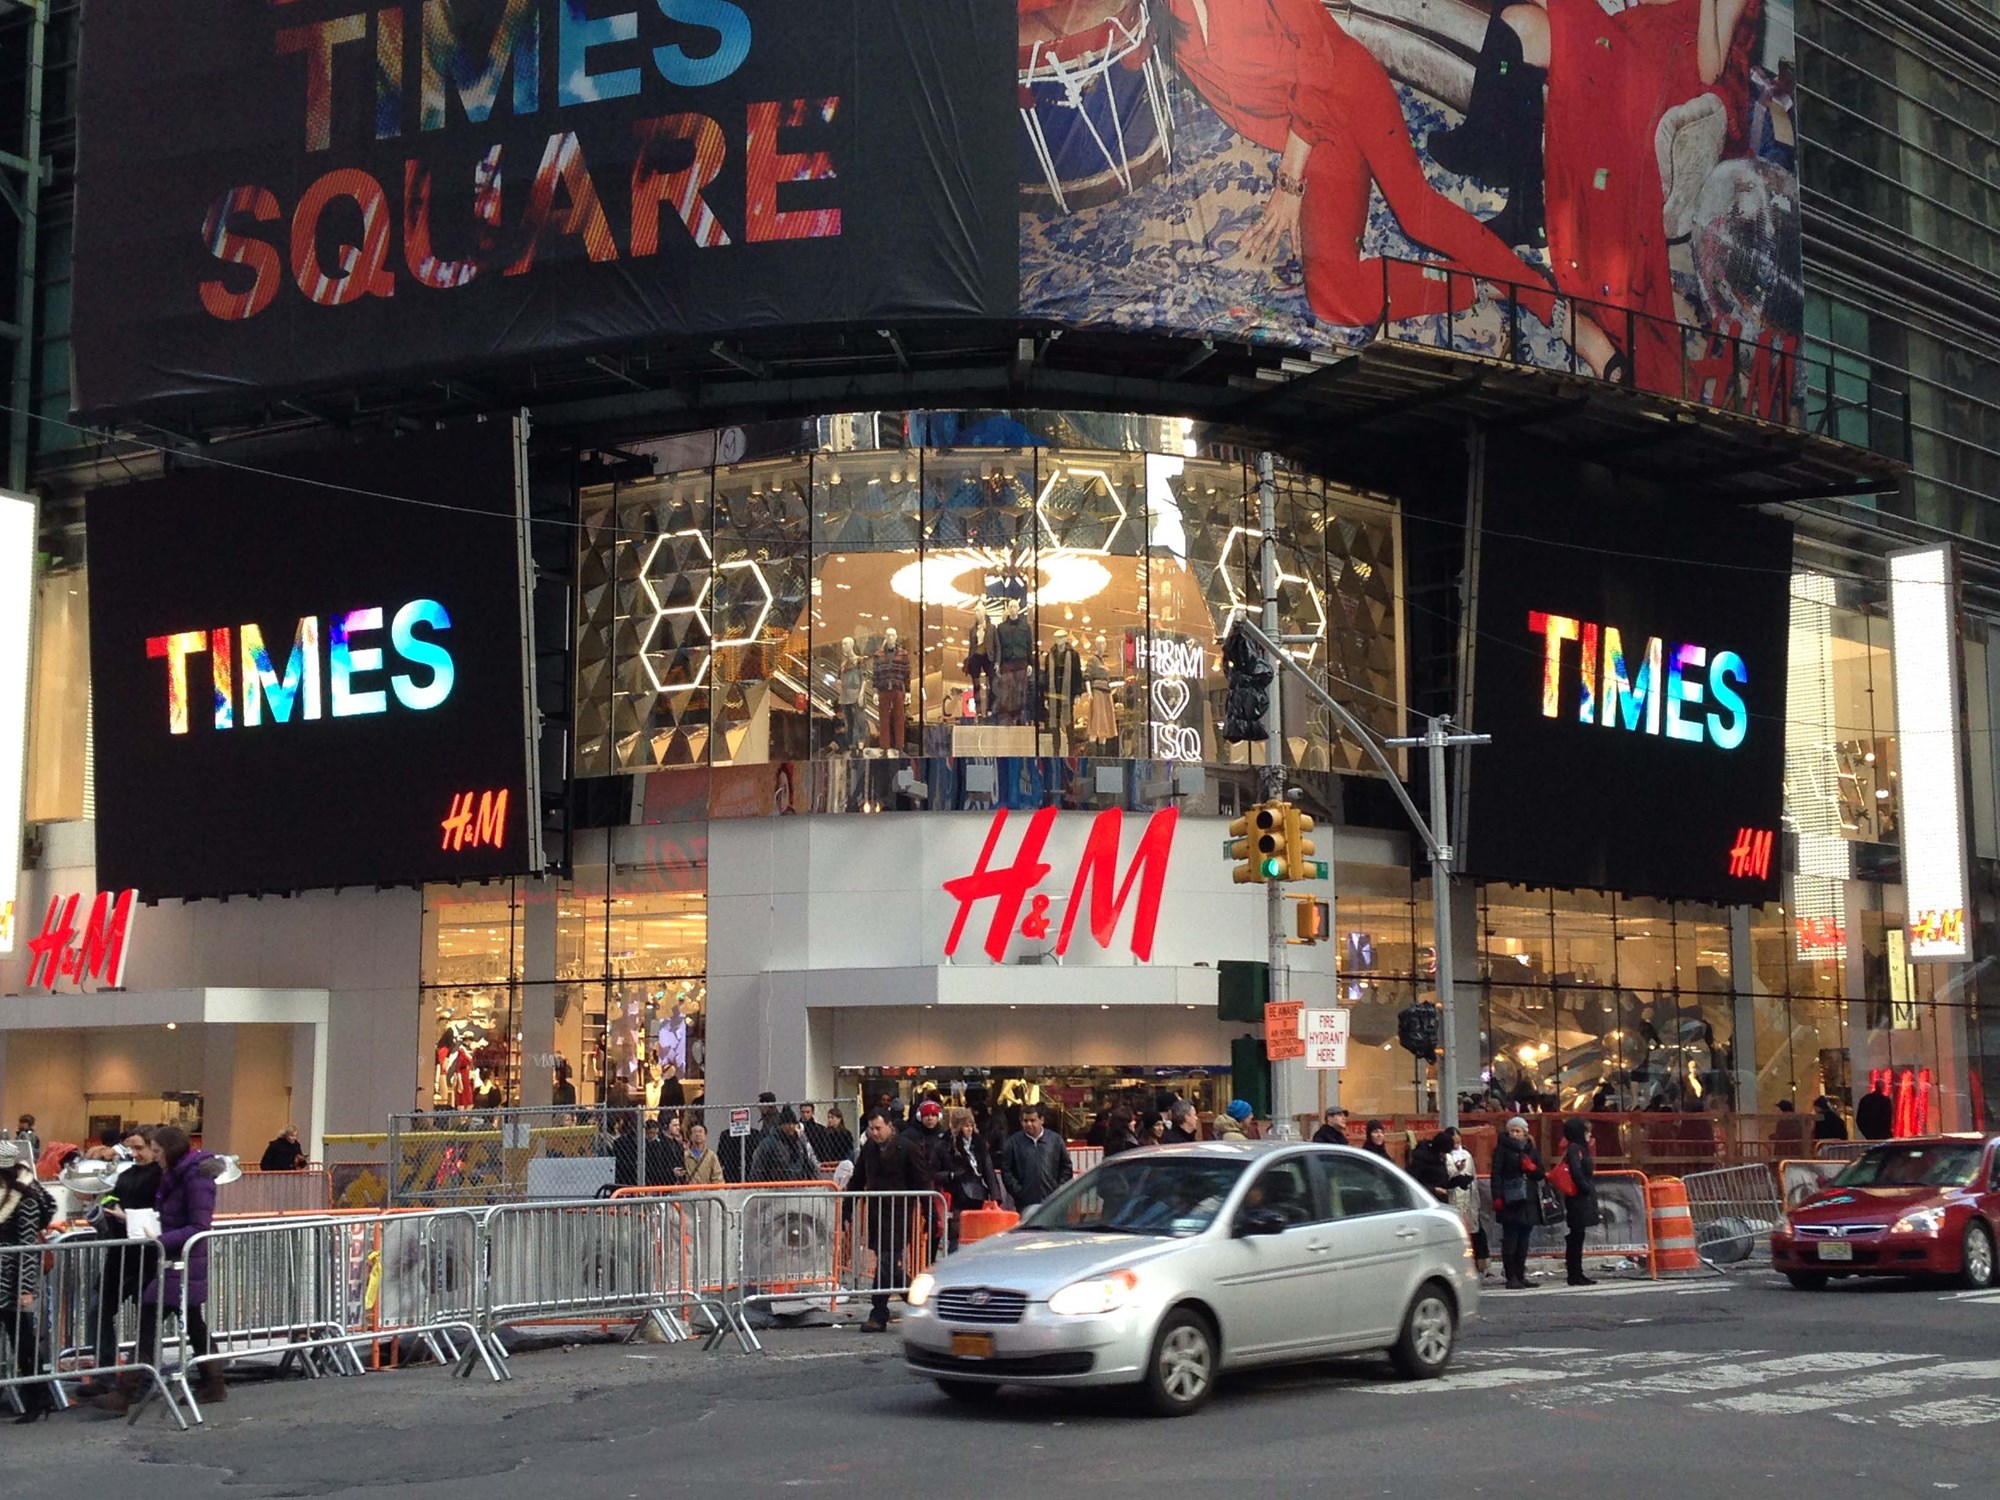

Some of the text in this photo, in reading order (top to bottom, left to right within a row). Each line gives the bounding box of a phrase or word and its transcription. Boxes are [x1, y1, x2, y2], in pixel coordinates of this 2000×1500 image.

[275, 0, 752, 152] TIMES
[200, 97, 842, 320] SQUARE
[1687, 317, 1798, 424] HM
[145, 599, 455, 734] TIMES
[1528, 610, 1748, 749] TIMES
[441, 788, 508, 851] H&M
[1729, 827, 1773, 881] H&M
[942, 806, 1179, 963] H&M
[1911, 908, 1965, 947] H&M
[26, 887, 134, 990] H&M
[1308, 1031, 1344, 1045] HYDRANT
[1317, 1048, 1336, 1062] HERE
[1319, 1015, 1335, 1029] FIRE
